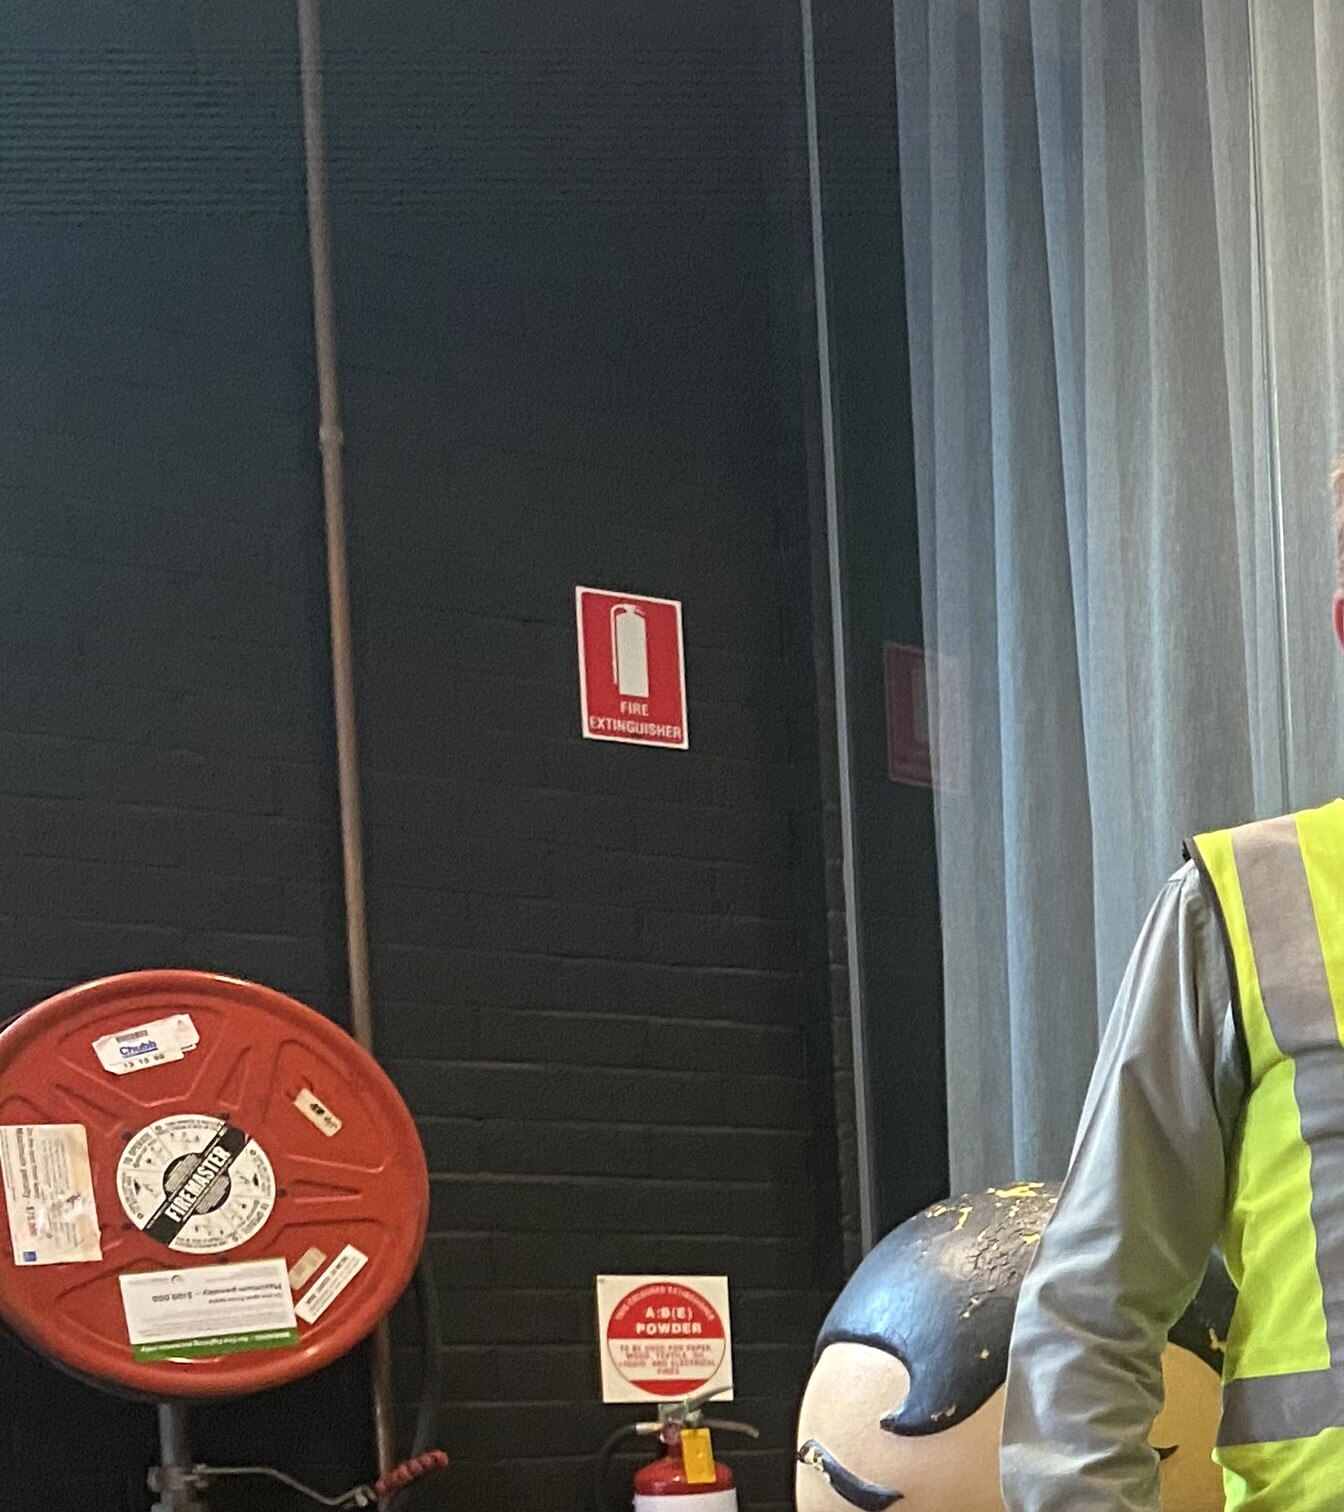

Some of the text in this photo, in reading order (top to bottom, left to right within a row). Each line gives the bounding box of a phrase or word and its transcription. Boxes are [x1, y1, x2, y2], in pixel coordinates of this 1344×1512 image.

[620, 701, 649, 716] FIRE
[589, 716, 682, 739] EXTINGUISHER
[119, 1040, 157, 1056] Chubb
[165, 1145, 232, 1223] FIREMASTER
[636, 1322, 702, 1335] POWDER
